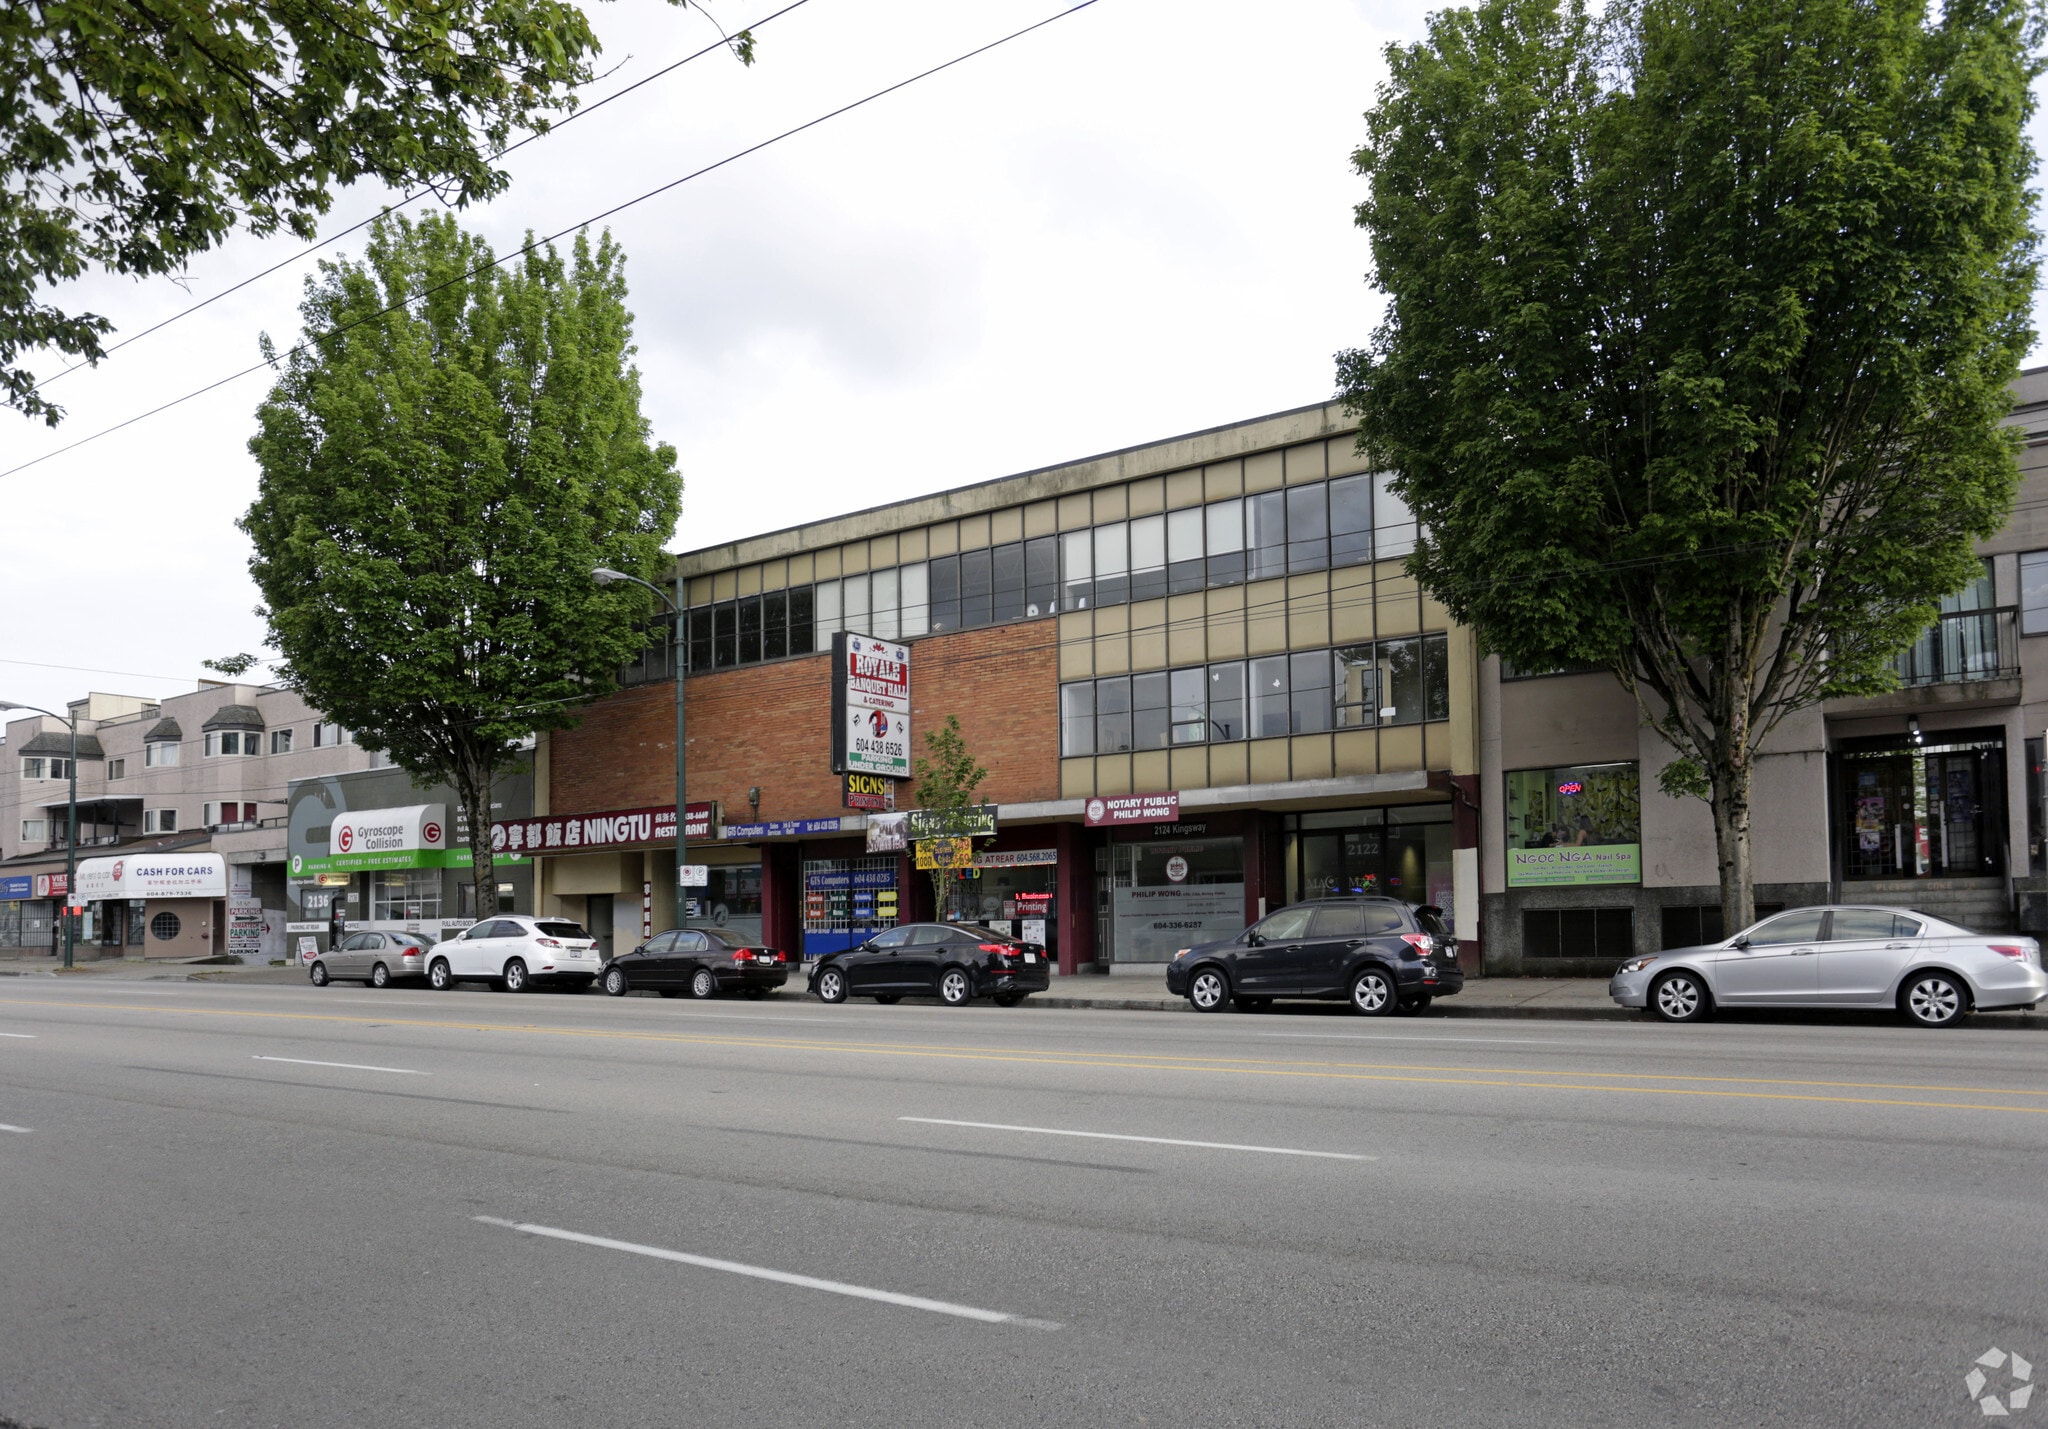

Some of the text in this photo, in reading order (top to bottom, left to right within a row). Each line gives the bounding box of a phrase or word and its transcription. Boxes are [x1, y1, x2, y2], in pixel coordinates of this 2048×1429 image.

[856, 655, 900, 682] ROYALE
[850, 677, 907, 697] BANQUET HALL
[868, 697, 895, 708] CATERING
[856, 738, 903, 756] 604 438 6526
[861, 753, 893, 765] PARKING
[849, 760, 907, 775] UNDER GROUND
[848, 774, 884, 796] SIGNS
[1558, 784, 1582, 793] OPEN
[1107, 796, 1177, 809] NOTARY PUBLIC
[1113, 807, 1170, 819] PHILIP WONG
[358, 825, 403, 839] Gyroscope
[583, 814, 651, 845] NINGTU
[655, 823, 708, 838] RESTRANT
[727, 826, 763, 837] GTS Computers
[1154, 823, 1207, 835] 2124 Kingsway
[366, 837, 403, 849] Collision
[1347, 843, 1379, 855] 2122
[382, 856, 412, 864] ESTIMATES
[985, 855, 995, 864] AT
[995, 854, 1015, 863] REAR
[1016, 852, 1056, 863] 604.568.2065
[1515, 853, 1555, 864] NGOC
[1559, 851, 1592, 862] NGA
[1616, 853, 1632, 862] Spa
[294, 858, 300, 870] P
[136, 866, 213, 876] CASH FOR CARS
[959, 868, 981, 879] LED
[810, 873, 890, 886] GTS Computers 604 438 0285
[1157, 890, 1181, 898] WONG
[308, 895, 329, 908] 2136
[1017, 902, 1047, 913] Printing
[1153, 921, 1202, 929] 604-336-6287
[230, 929, 259, 937] PARKING
